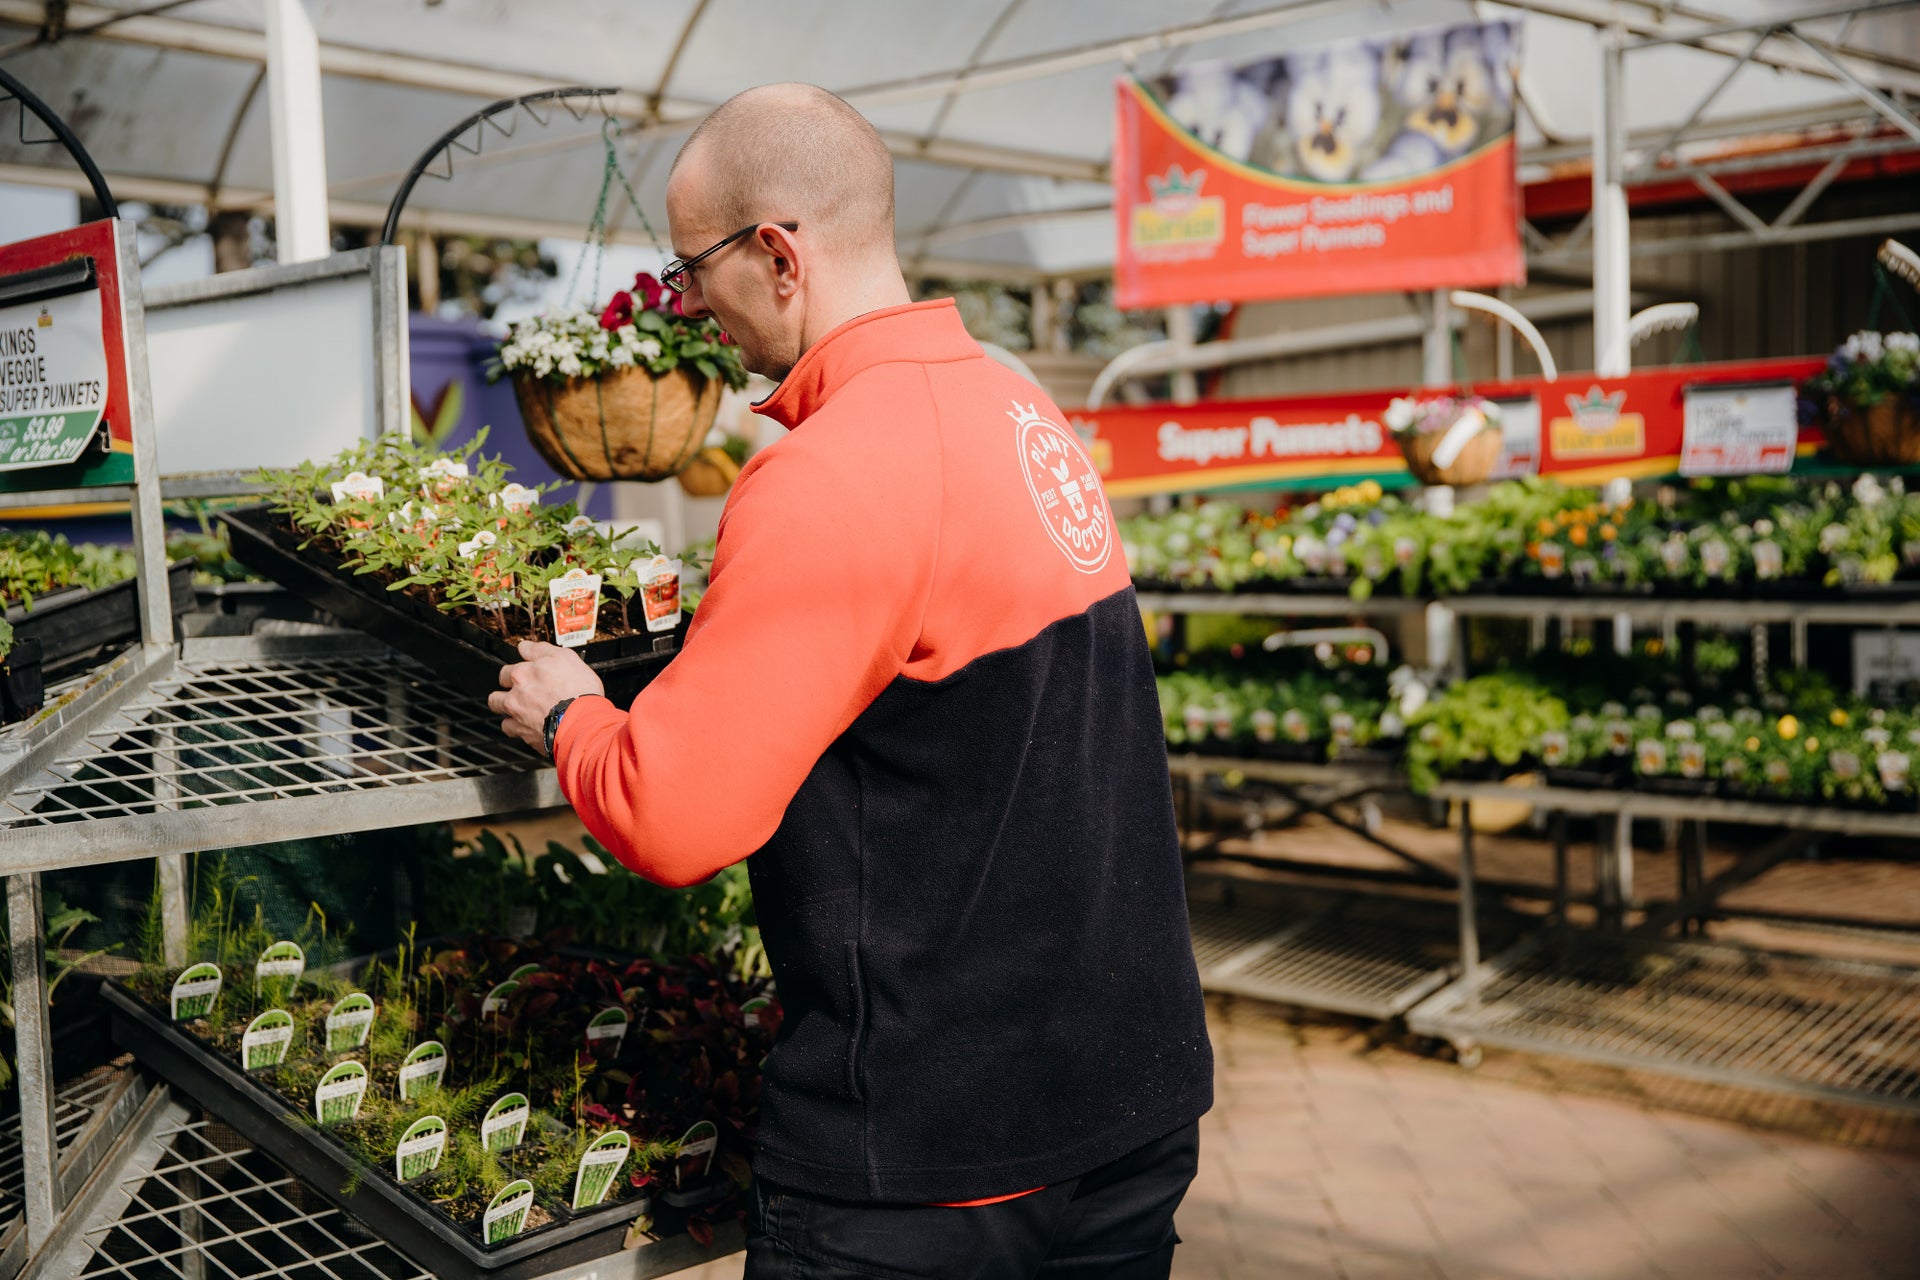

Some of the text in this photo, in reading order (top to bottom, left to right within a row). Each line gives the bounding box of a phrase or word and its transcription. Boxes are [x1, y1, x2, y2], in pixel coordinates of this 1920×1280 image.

[1311, 195, 1408, 224] Seedlings
[1412, 184, 1453, 213] and
[1242, 230, 1299, 260] Super
[1302, 223, 1385, 250] Punnets
[0, 381, 100, 412] SUPER PUNNETS
[23, 415, 66, 443] $3.99
[1158, 414, 1383, 465] Super Punnets
[9, 444, 25, 463] or
[25, 442, 37, 461] 3
[35, 440, 58, 461] for
[54, 436, 84, 459] $11
[1031, 432, 1069, 469] PLANT
[1041, 487, 1057, 503] PEST
[1062, 504, 1104, 552] DOCTOR
